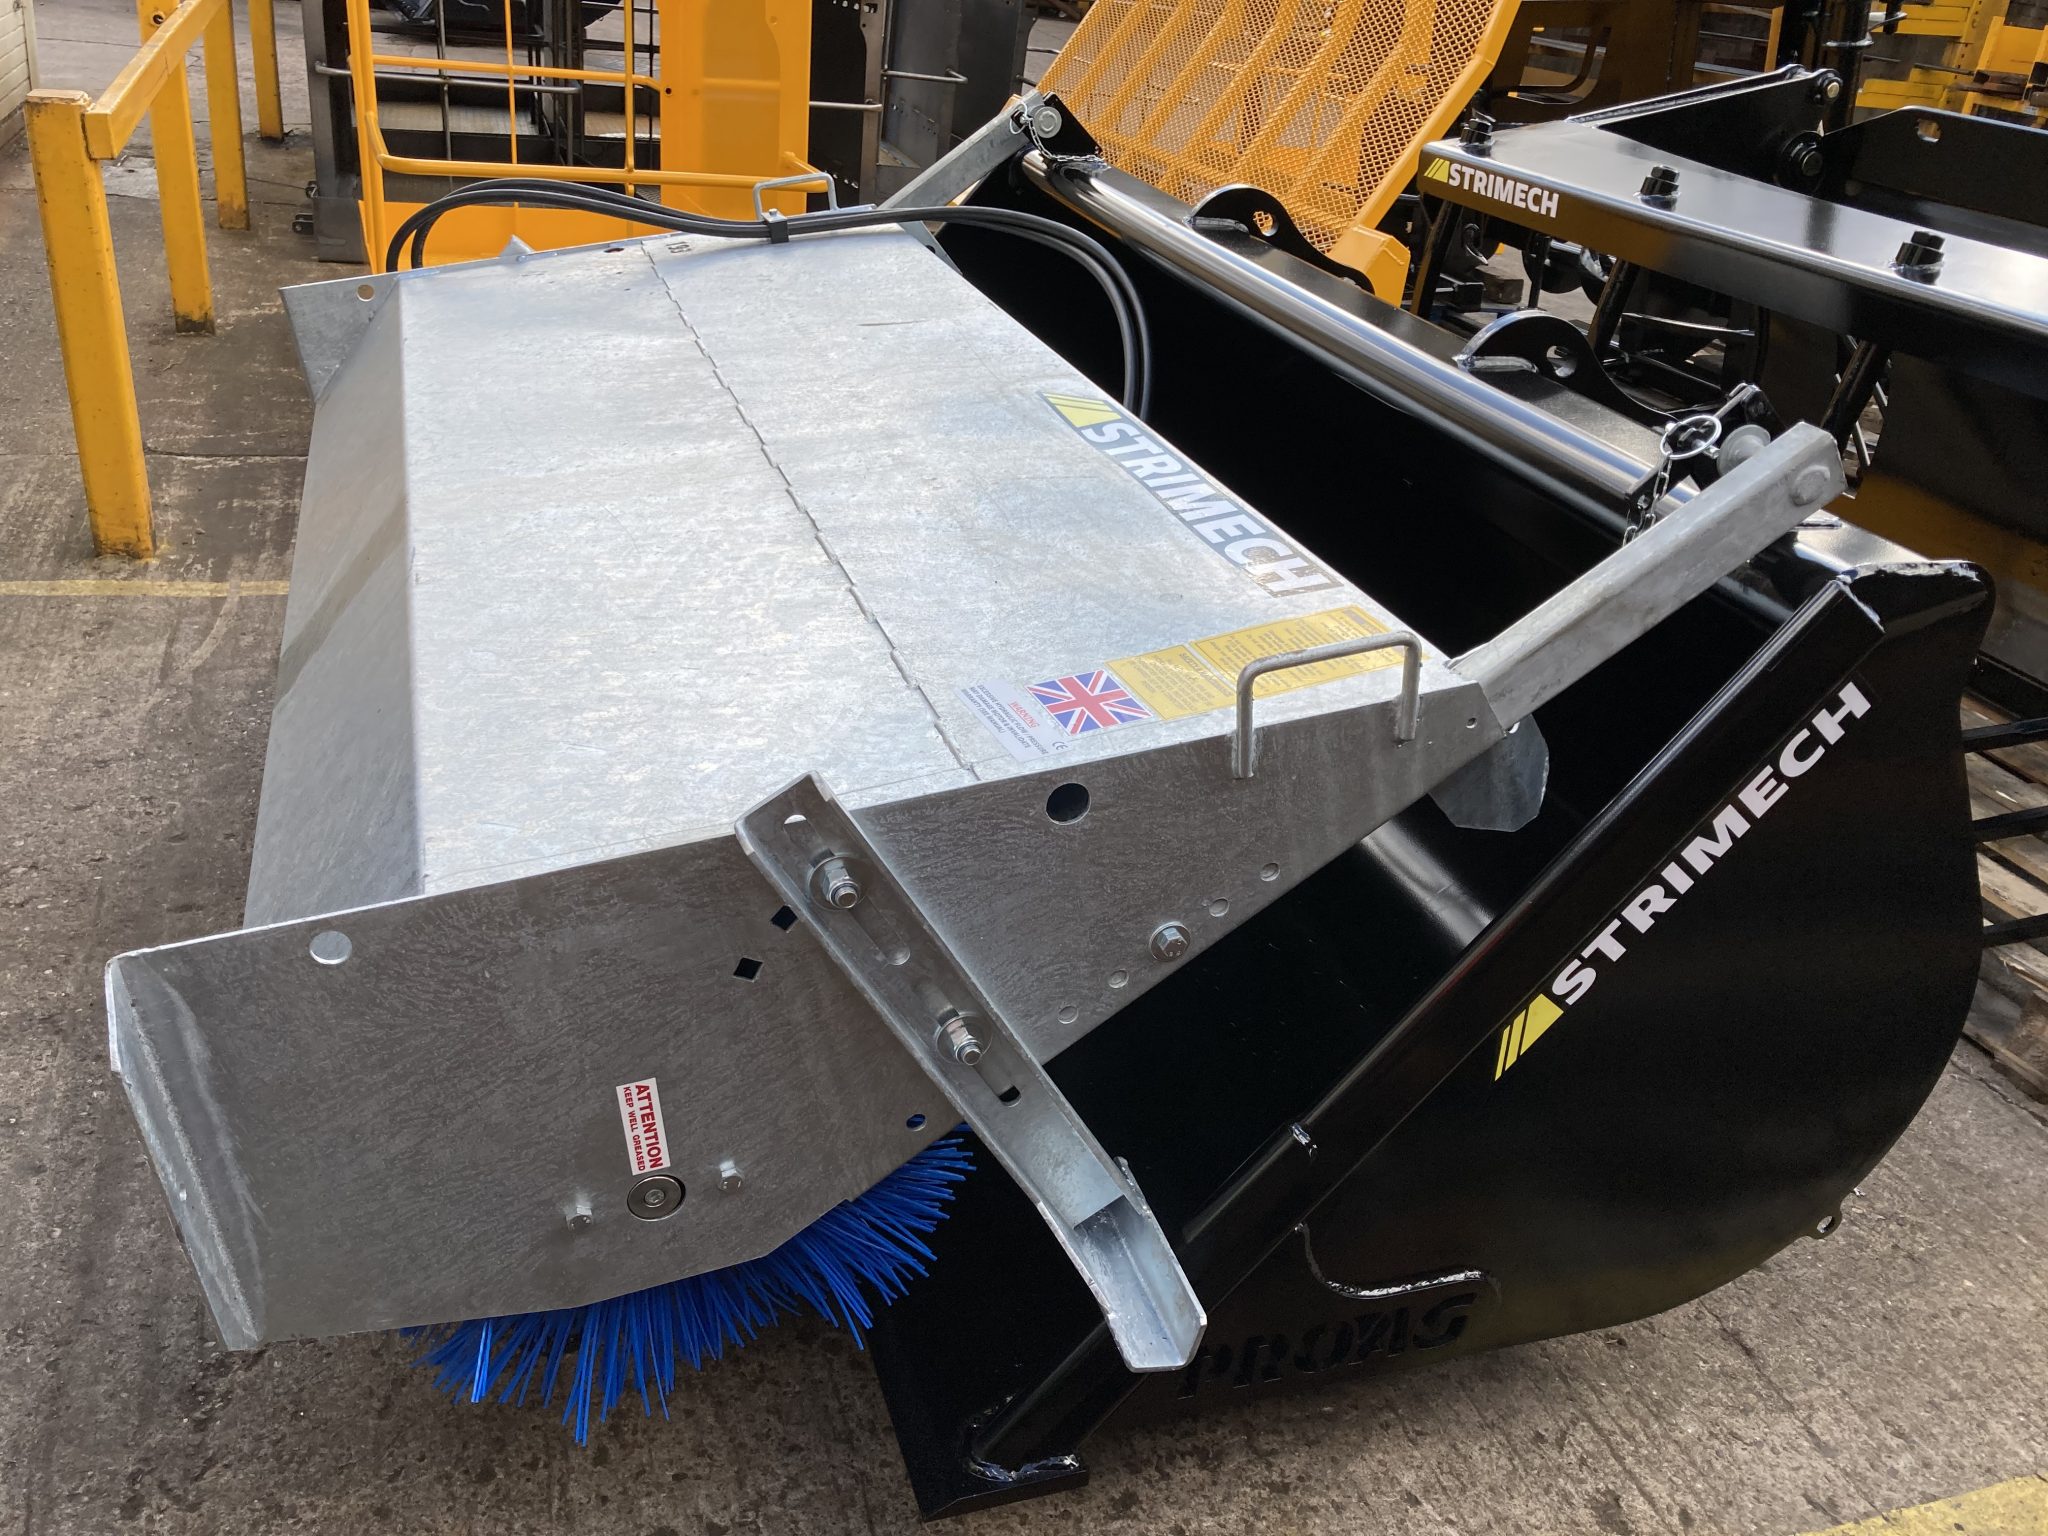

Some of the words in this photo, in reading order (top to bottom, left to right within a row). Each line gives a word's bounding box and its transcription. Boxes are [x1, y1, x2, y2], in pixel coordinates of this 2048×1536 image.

[1449, 163, 1560, 218] STRIMECH
[1082, 421, 1332, 593] STRIMECH
[1010, 701, 1040, 728] WARNING
[1551, 681, 1873, 1005] STRIMECH
[623, 1086, 633, 1107] KEEP
[628, 1111, 638, 1132] WELL
[635, 1085, 663, 1168] ATTENTION
[632, 1135, 645, 1171] GREASED
